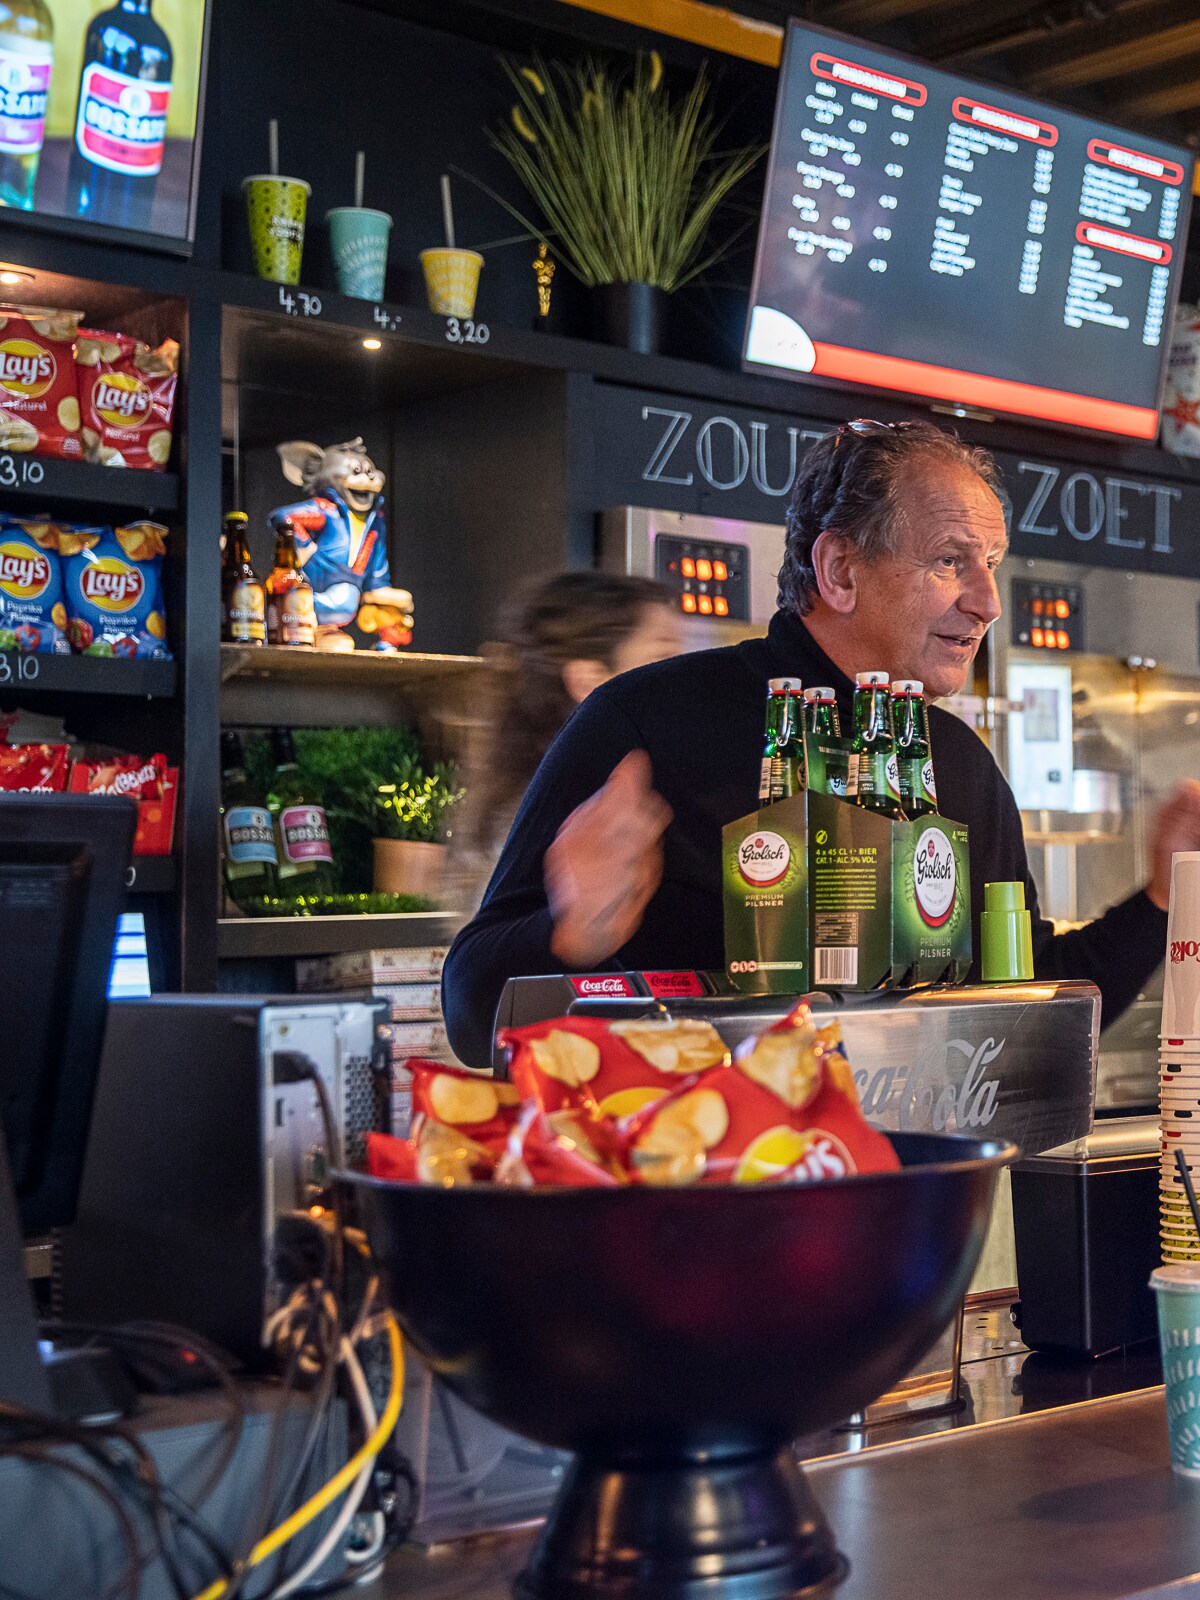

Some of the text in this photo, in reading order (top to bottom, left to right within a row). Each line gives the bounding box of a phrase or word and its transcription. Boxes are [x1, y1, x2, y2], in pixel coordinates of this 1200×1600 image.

[446, 318, 490, 344] 3,20
[96, 383, 148, 416] Lay's
[0, 455, 44, 487] 3,10
[1018, 461, 1182, 554] ZOET
[87, 570, 139, 602] Lay's
[741, 844, 785, 864] Grolsch
[851, 856, 861, 864] 5%
[861, 856, 878, 864] VOL.
[859, 847, 877, 855] BIER
[916, 849, 952, 885] Grolsch
[920, 948, 952, 958] PILSNER
[581, 978, 624, 993] Coca-Cola
[651, 975, 692, 988] Coca-Cola
